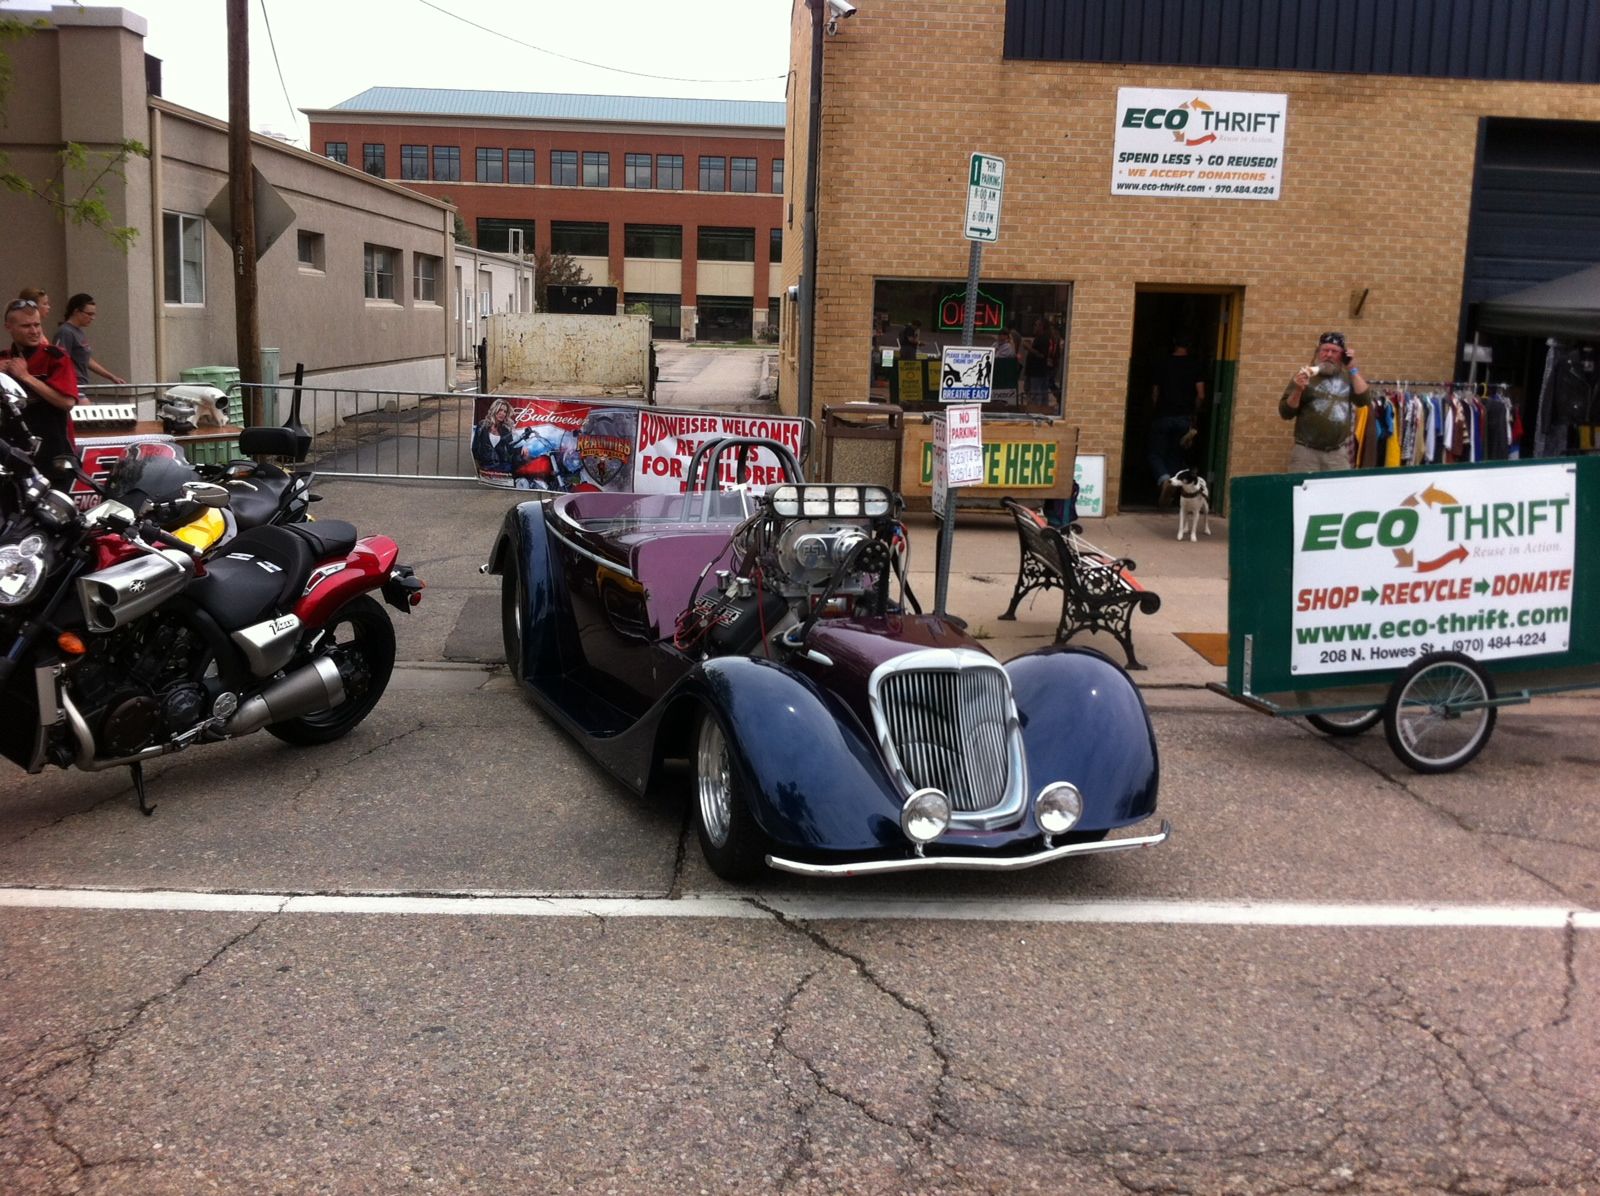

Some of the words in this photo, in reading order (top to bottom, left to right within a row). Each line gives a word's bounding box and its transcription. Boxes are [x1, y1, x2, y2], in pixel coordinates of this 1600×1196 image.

[1122, 108, 1189, 130] ECO
[1201, 111, 1280, 133] THRIFT
[974, 160, 979, 182] 1
[1118, 152, 1158, 163] SPEND
[1162, 154, 1191, 165] LESS
[1208, 156, 1224, 166] GO
[1227, 156, 1278, 168] REUSED!
[1128, 168, 1148, 177] WE
[1150, 169, 1195, 179] ACCEPT
[1198, 170, 1266, 181] DONATIONS
[1117, 182, 1205, 192] www.eco-thrift.com
[1214, 185, 1274, 194] 970.484.4224
[943, 388, 970, 399] BREATHE
[972, 389, 988, 399] EASY
[512, 408, 589, 426] Budweiser
[960, 411, 970, 424] NO
[638, 413, 718, 453] BUDWEISER
[722, 418, 800, 462] WELCOMES
[952, 426, 976, 440] PARKING
[642, 456, 683, 478] FOR
[1005, 443, 1056, 485] HERE
[1302, 507, 1419, 552] ECO
[1440, 498, 1570, 542] THRIFT
[1473, 545, 1507, 559] Reuse
[1509, 545, 1521, 556] in
[1523, 542, 1563, 555] Action.
[1296, 586, 1360, 612] SHOP
[1380, 577, 1472, 606] RECYCLE
[1492, 569, 1572, 597] DONATE
[1296, 605, 1569, 645] www.eco-thrift.com
[1320, 650, 1348, 664] 208
[1351, 648, 1366, 662] N.
[1370, 644, 1416, 660] Howes
[1452, 638, 1484, 653] (970)
[1487, 632, 1546, 650] 484-4224
